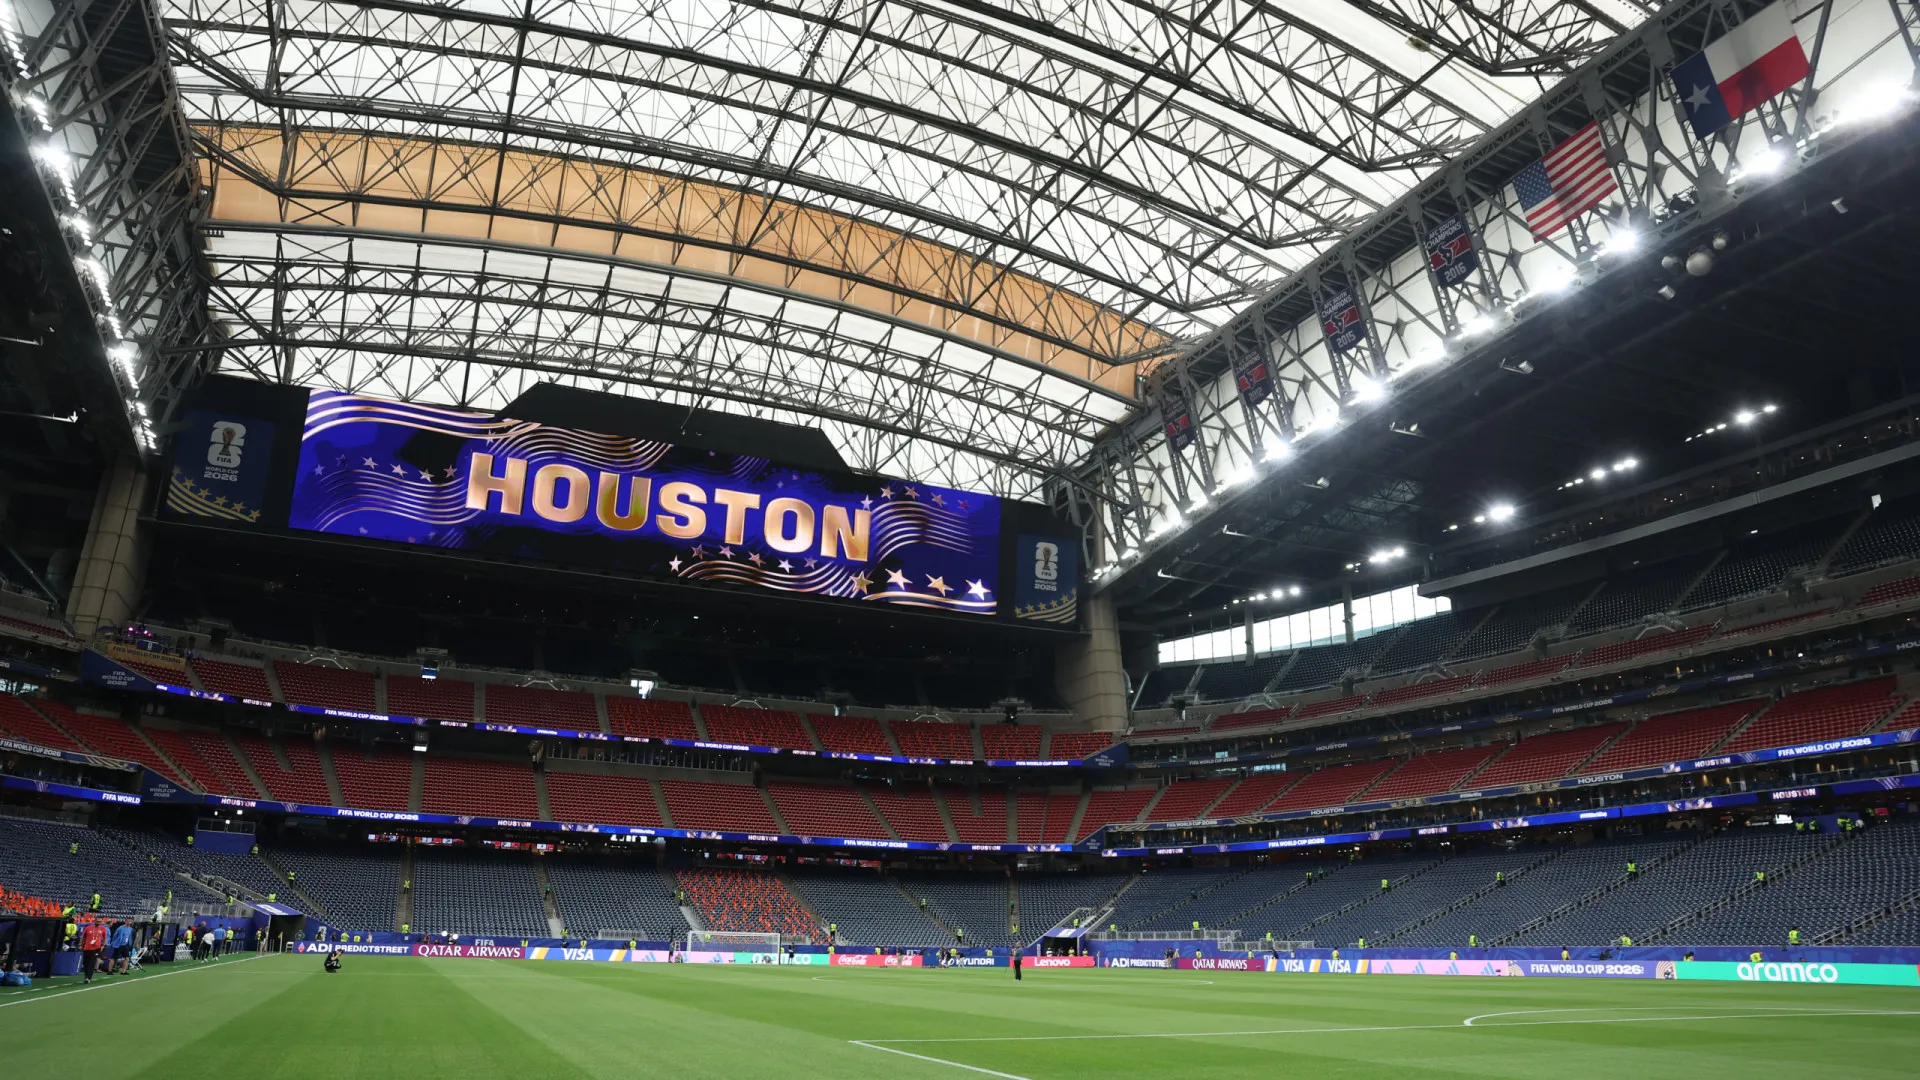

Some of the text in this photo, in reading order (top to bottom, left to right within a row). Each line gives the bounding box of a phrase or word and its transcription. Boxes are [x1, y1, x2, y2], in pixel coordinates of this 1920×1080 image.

[1428, 218, 1456, 240] AFC SOUTH
[1424, 222, 1462, 249] CHAMPIONS
[1444, 262, 1466, 282] 2016
[1322, 295, 1352, 318] CHAMPIONS
[1336, 331, 1356, 348] 2015
[204, 471, 238, 482] 2026
[466, 451, 872, 562] HOUSTON
[242, 699, 272, 707] HOUSTON
[13, 743, 33, 751] WORLD
[1316, 742, 1348, 751] HOUSTON
[1778, 738, 1871, 757] FIFA WORLD CUP 2026
[1694, 758, 1730, 768] HOUSTON
[1578, 773, 1624, 784] HOUSTON
[1772, 788, 1816, 799] HOUSTON
[118, 795, 140, 804] WORLD
[221, 798, 256, 807] HOUSTON
[1310, 807, 1344, 816] HOUSTON
[1418, 827, 1448, 835] HOUSTON
[306, 944, 409, 954] ADI PREDICTSTREET
[418, 945, 520, 958] QATAR AIRWAYS
[562, 948, 594, 960] VISA
[838, 954, 868, 966] Coca-Cola
[1034, 957, 1071, 967] Lenovo
[1111, 957, 1130, 968] ADI
[1192, 959, 1247, 970] QATAR AIRWAYS
[1283, 960, 1304, 972] VISA
[1327, 960, 1351, 973] VISA
[1530, 963, 1641, 975] FIFA WORLD CUP 2026
[1737, 963, 1838, 983] aramco
